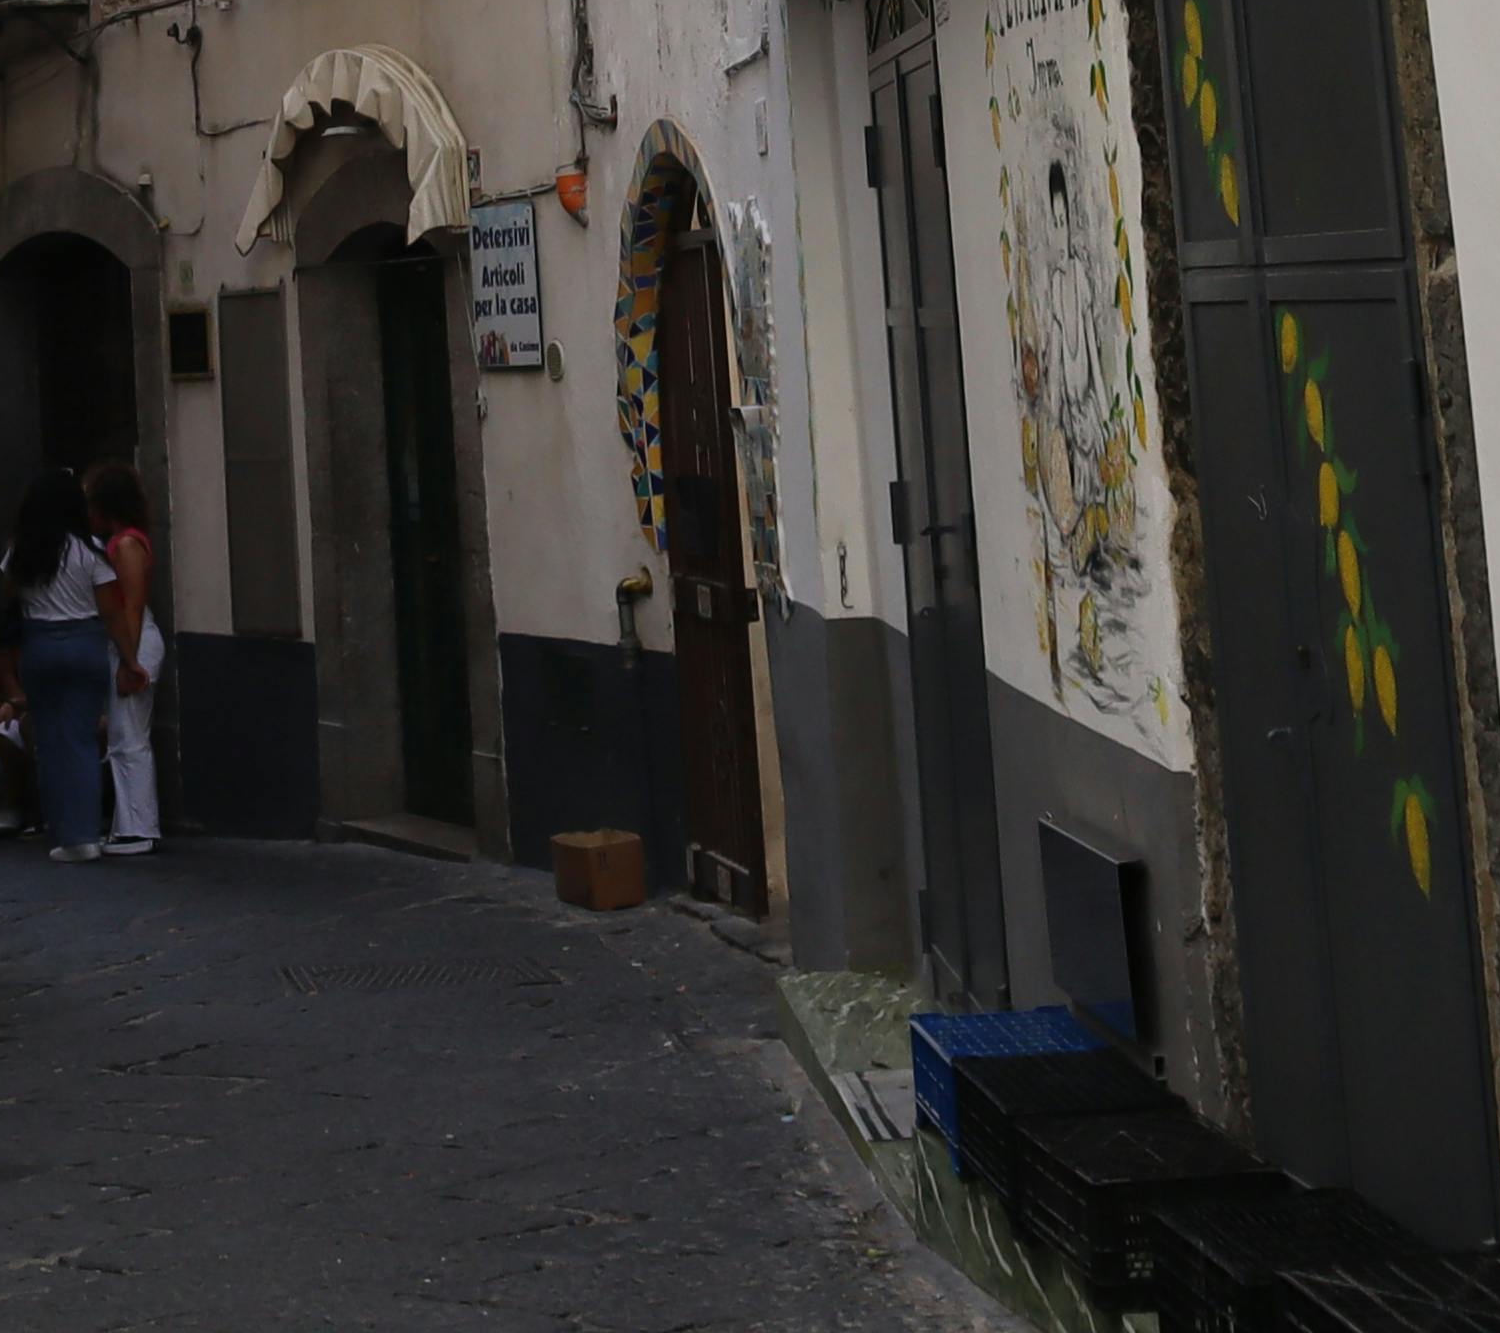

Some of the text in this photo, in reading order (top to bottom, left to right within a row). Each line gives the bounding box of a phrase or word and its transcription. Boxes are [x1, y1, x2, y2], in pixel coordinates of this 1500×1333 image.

[472, 219, 531, 251] Detersivi
[481, 261, 525, 288] Articoli
[474, 293, 538, 321] per la casa
